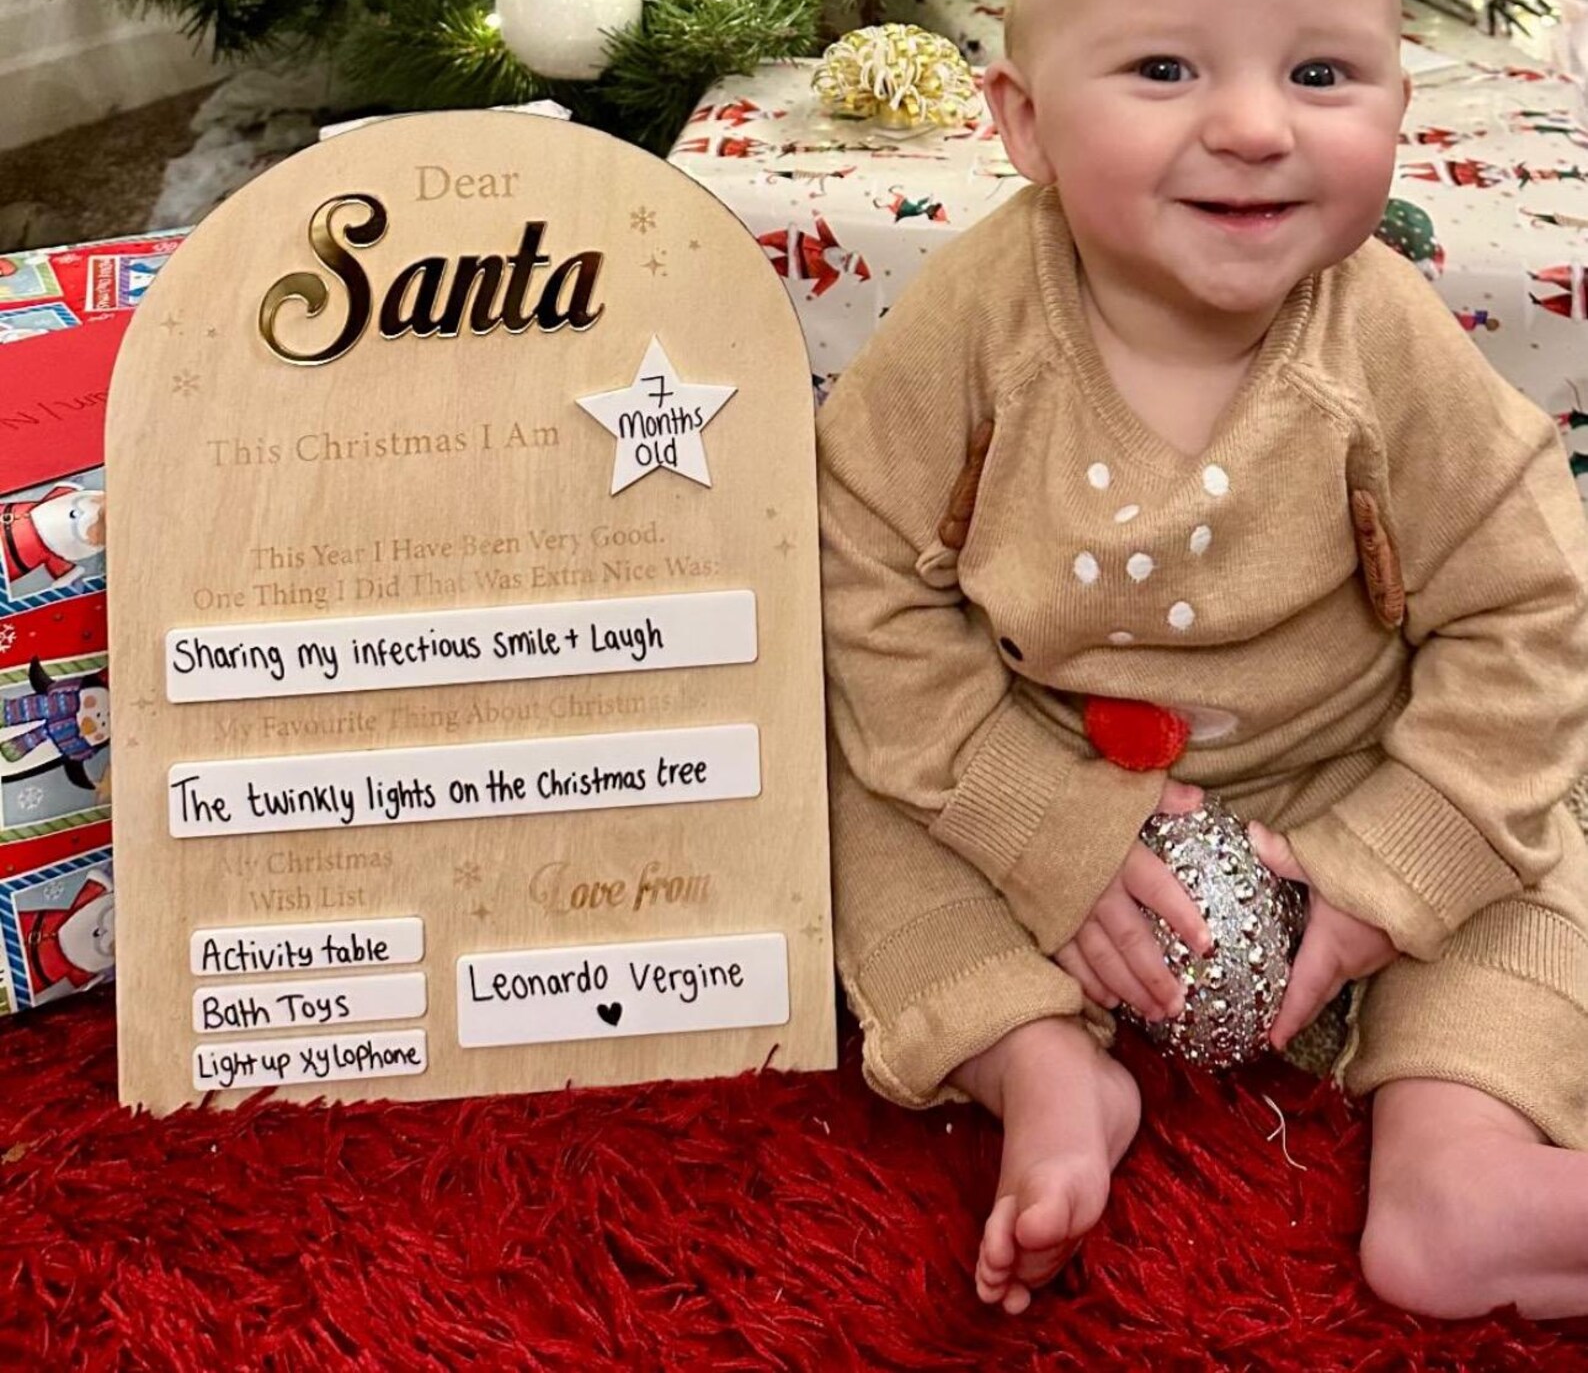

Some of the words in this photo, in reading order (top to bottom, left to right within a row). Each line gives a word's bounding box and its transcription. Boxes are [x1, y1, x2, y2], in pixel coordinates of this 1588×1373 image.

[415, 165, 519, 201] Dear
[258, 193, 606, 367] Santa
[640, 375, 674, 408] 7
[206, 439, 281, 467] This
[296, 429, 467, 462] Christmas
[482, 424, 491, 450] I
[506, 421, 560, 448] Am
[618, 406, 703, 438] Months
[250, 546, 305, 570] This
[313, 543, 365, 566] Year
[392, 538, 453, 561] Have
[462, 533, 521, 557] Been
[530, 529, 581, 555] Very
[591, 523, 665, 548] Good.
[193, 587, 246, 610] One
[253, 581, 327, 610] Thing
[356, 575, 400, 600] Did
[408, 570, 464, 596] That
[474, 567, 522, 590] Was
[531, 563, 593, 589] Extra
[602, 559, 656, 584] Nice
[172, 637, 284, 681] Sharing
[298, 642, 338, 680] my
[352, 628, 481, 667] infectious
[262, 709, 377, 739] Favourite
[391, 704, 461, 734] Thing
[467, 696, 539, 726] About
[549, 691, 671, 720] Christmas
[170, 776, 231, 822] The
[248, 782, 355, 825] twinkly
[366, 776, 435, 820] lights
[486, 770, 526, 803] the
[537, 766, 646, 799] Christmas
[656, 757, 707, 787] tree
[266, 849, 394, 875] Christmas
[250, 885, 312, 912] Wish
[320, 886, 368, 908] List
[528, 861, 626, 917] Love
[633, 861, 710, 912] from
[202, 938, 313, 972] Activity
[321, 933, 390, 964] table
[469, 960, 608, 1002] Leonardo
[629, 963, 744, 1003] Vergine
[202, 996, 271, 1030] Bath
[275, 994, 350, 1023] Toys
